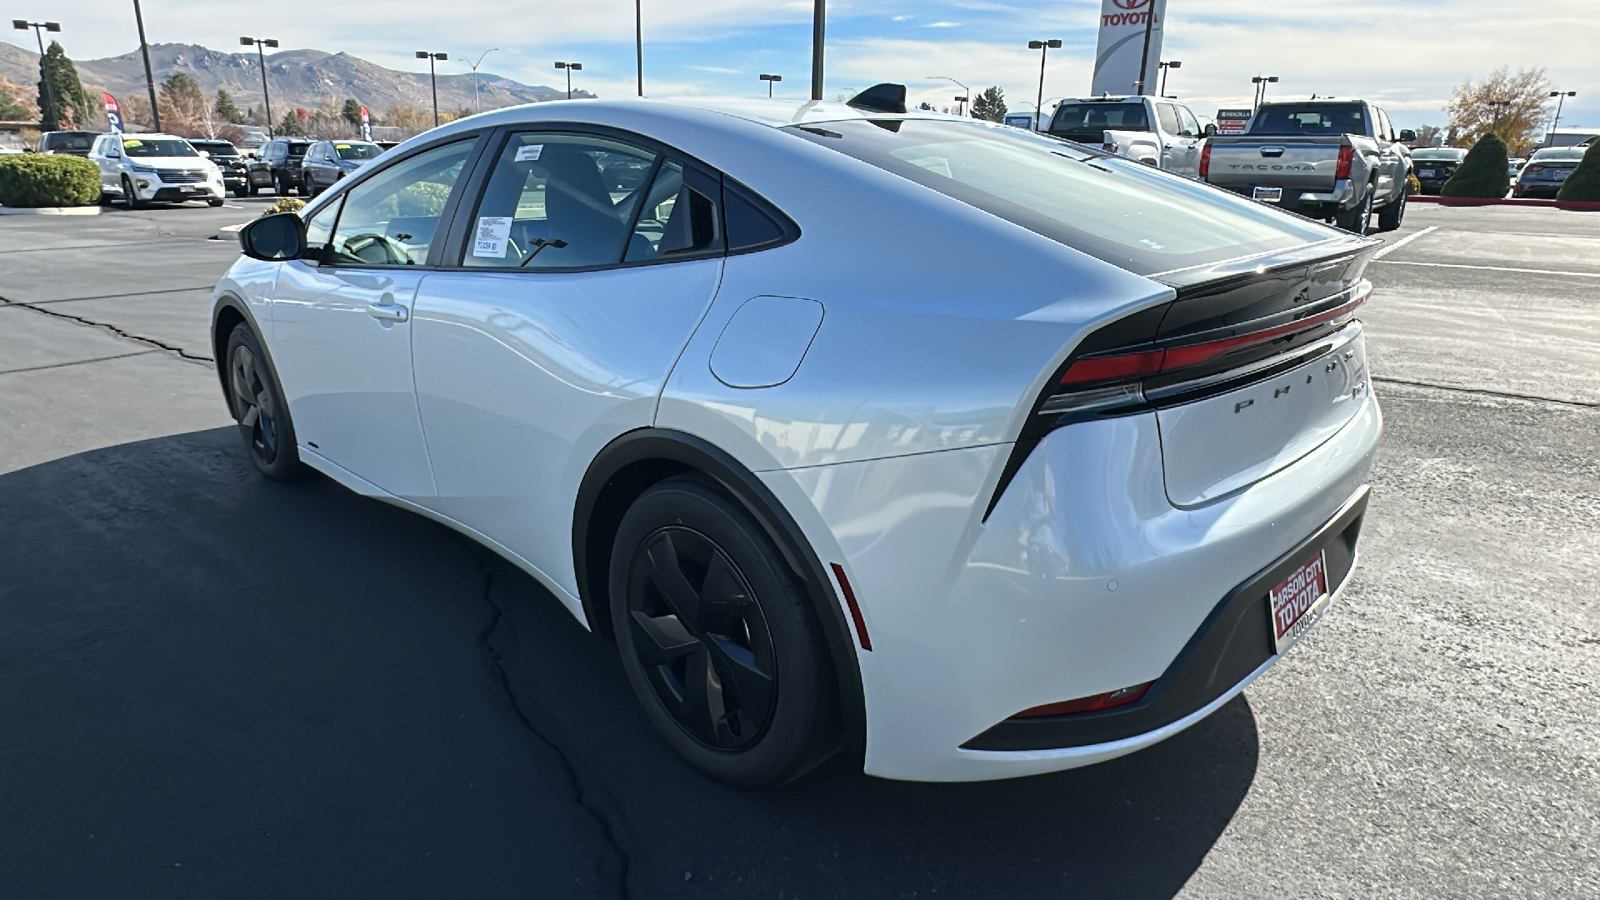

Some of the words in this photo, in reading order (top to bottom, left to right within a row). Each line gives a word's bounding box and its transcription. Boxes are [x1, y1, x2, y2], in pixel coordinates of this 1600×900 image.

[1272, 574, 1306, 611] CARSON
[1305, 557, 1322, 583] CITY
[1278, 579, 1320, 632] TOYOTA
